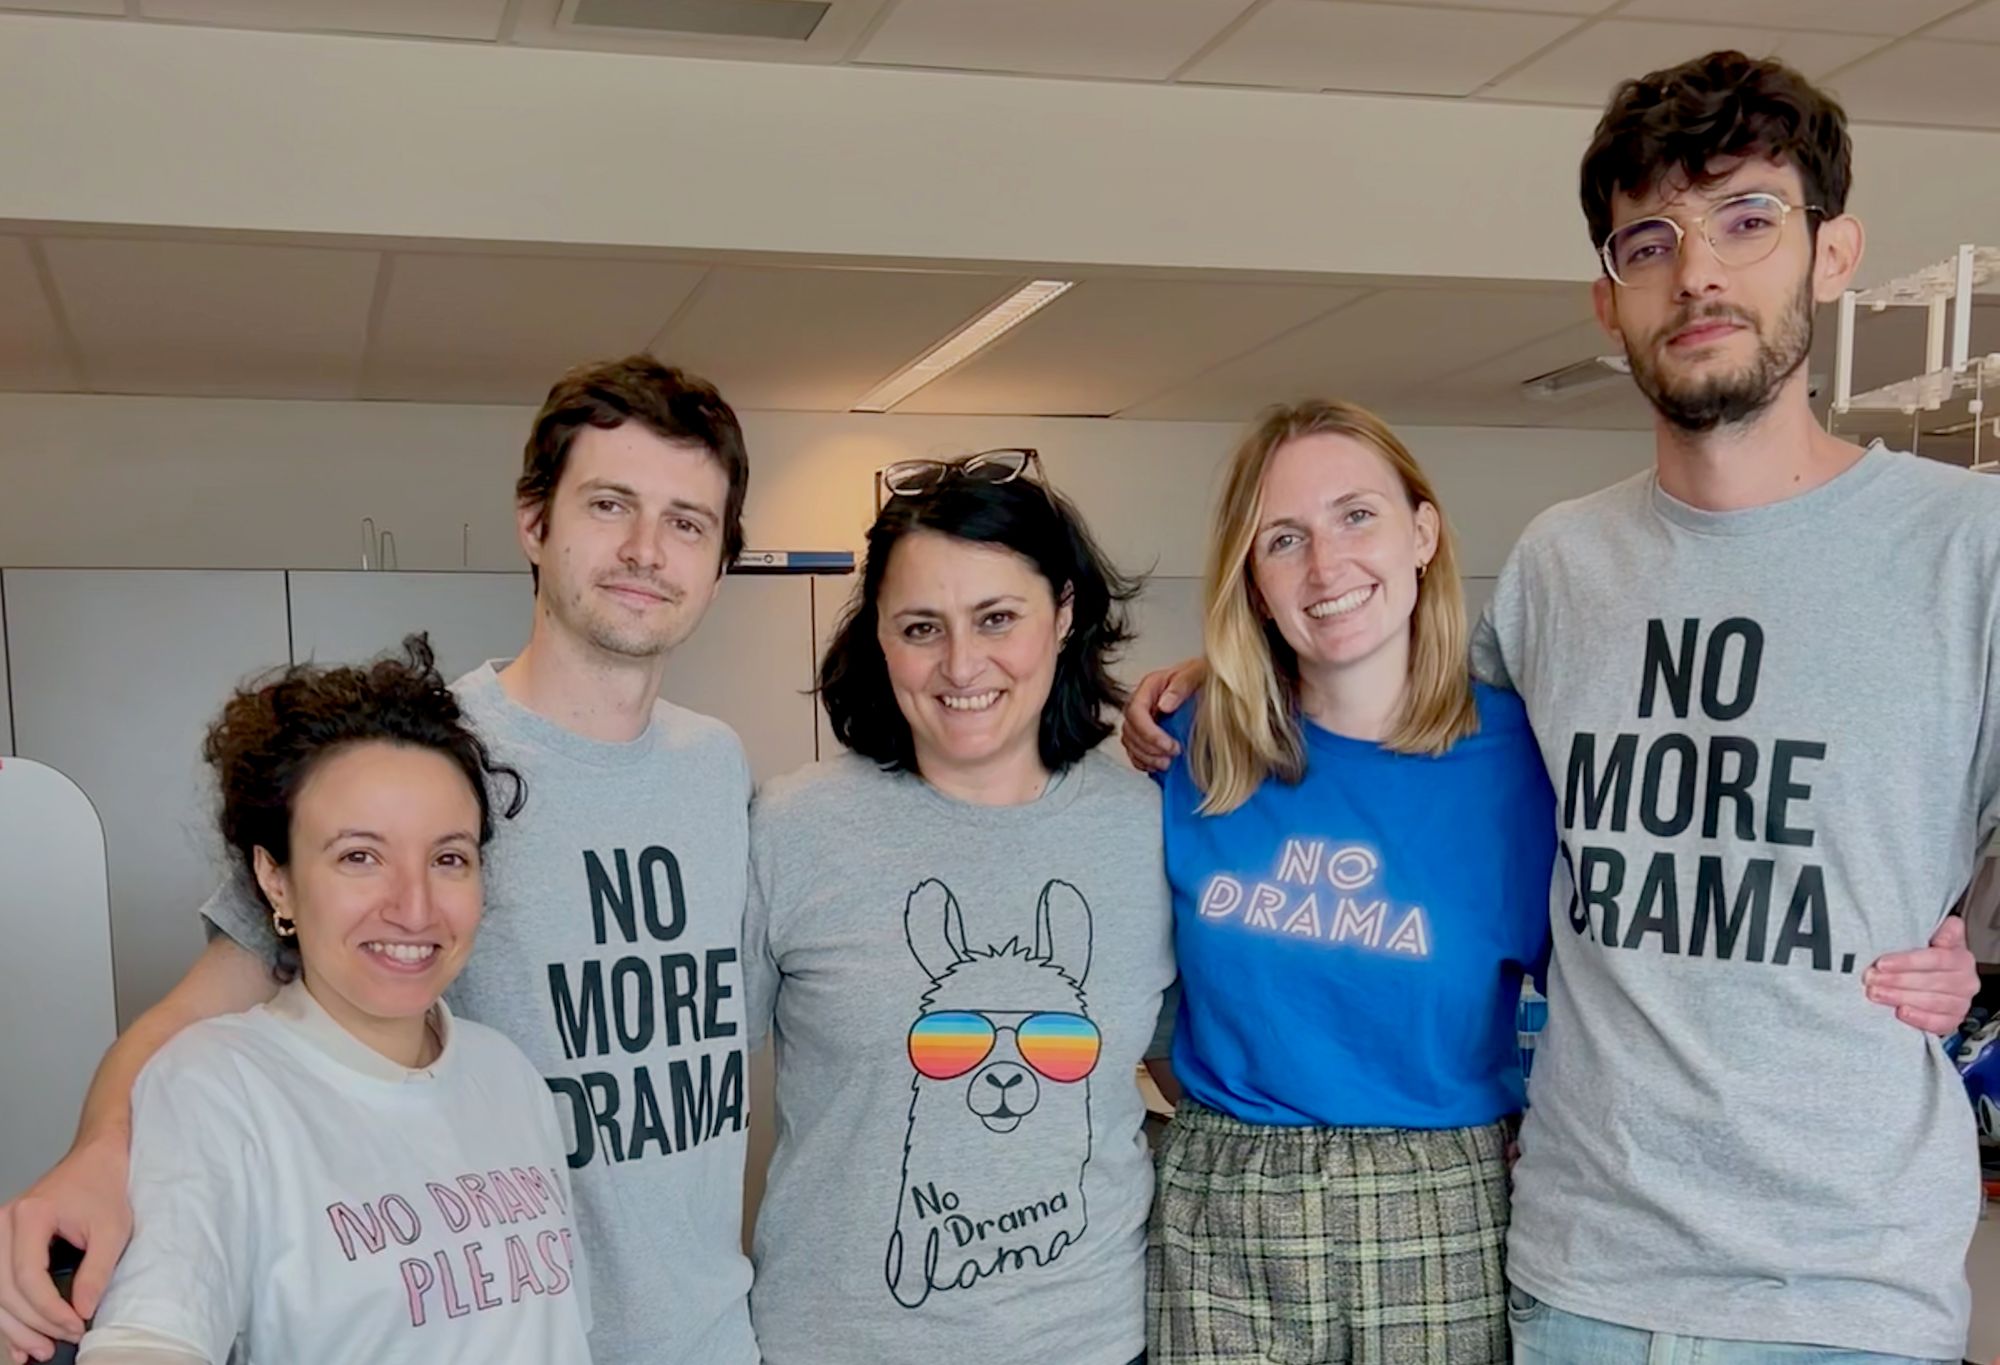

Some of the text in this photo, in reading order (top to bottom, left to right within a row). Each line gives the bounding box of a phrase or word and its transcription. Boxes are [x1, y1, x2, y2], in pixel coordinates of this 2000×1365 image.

[1637, 616, 1765, 721] NO
[1564, 732, 1827, 847] MORE
[582, 845, 687, 945] NO
[1276, 839, 1378, 891] NO
[1199, 875, 1428, 956] DRAMA
[547, 947, 738, 1060] MORE
[326, 1166, 567, 1262] NO DRAM
[911, 1181, 960, 1220] No
[943, 1191, 1068, 1248] Drama
